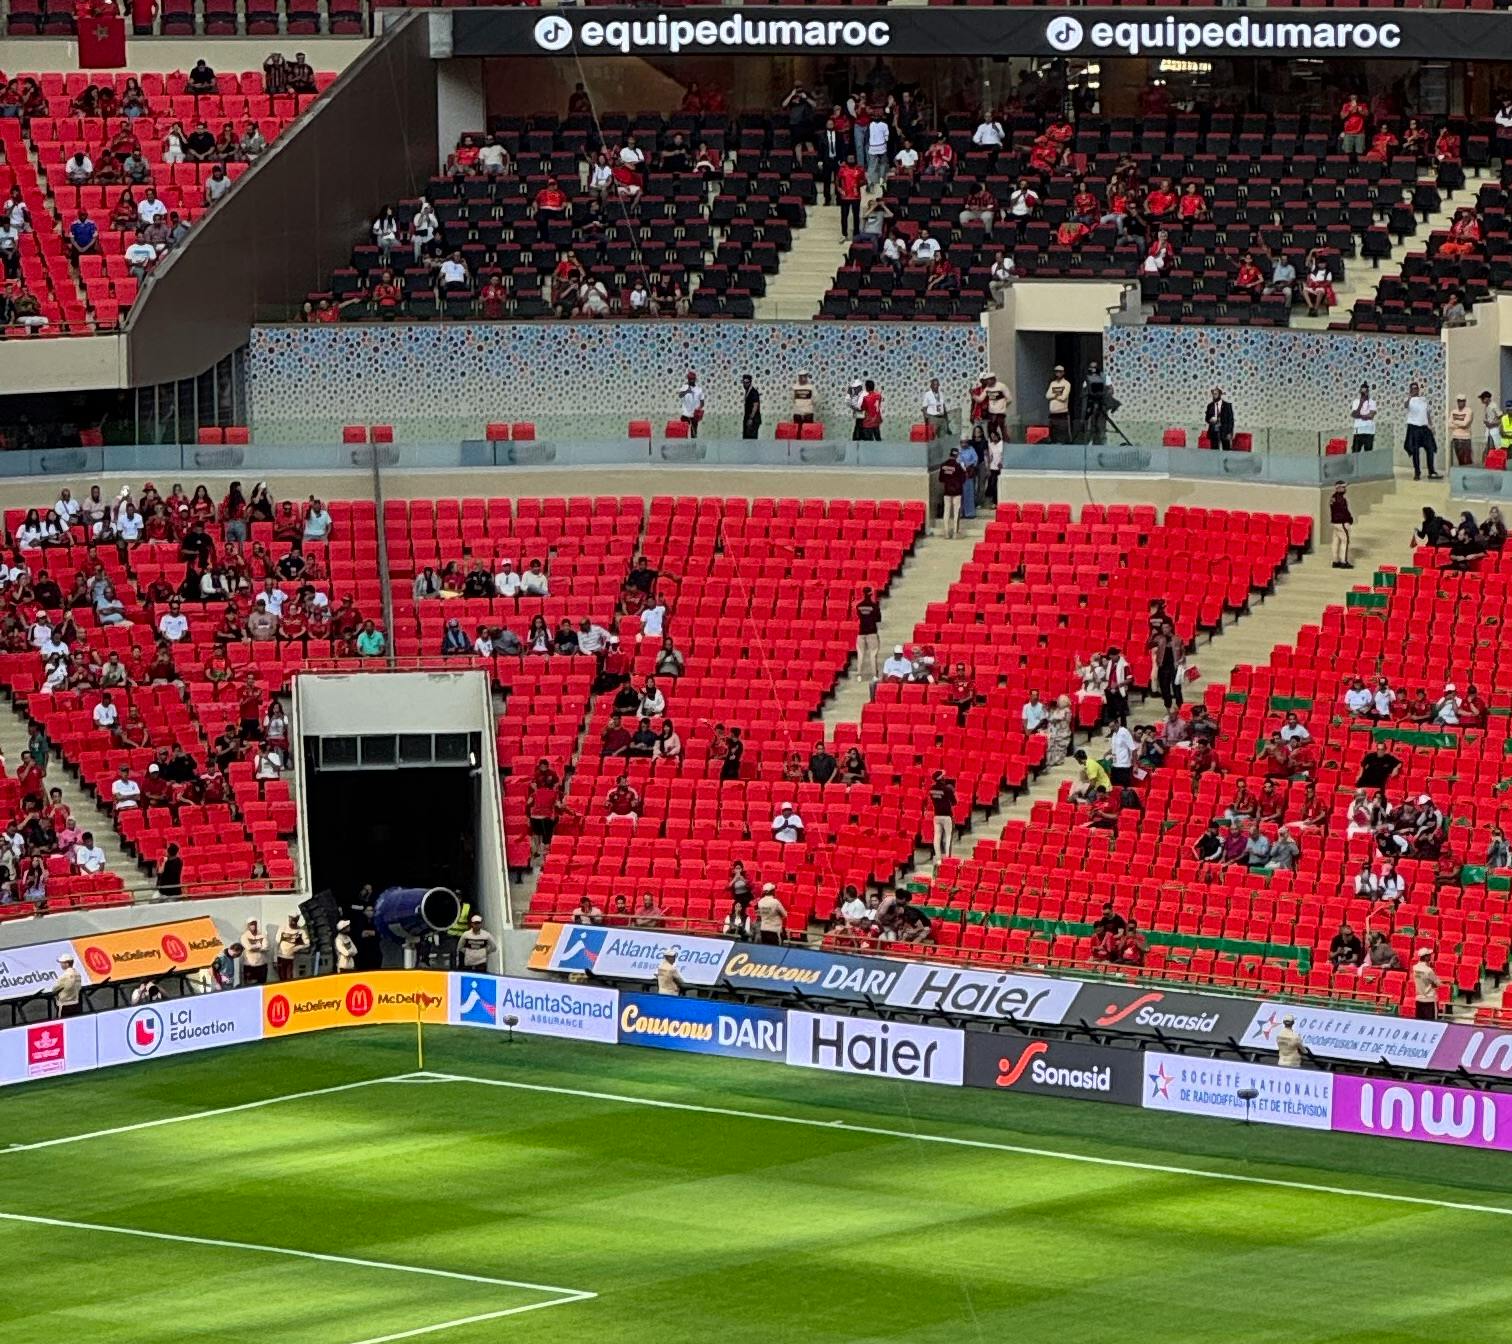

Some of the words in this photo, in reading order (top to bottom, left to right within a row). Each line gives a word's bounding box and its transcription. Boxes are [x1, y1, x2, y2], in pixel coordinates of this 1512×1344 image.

[581, 14, 889, 52] equipedumaroc
[1091, 16, 1400, 54] equipedumaroc
[0, 970, 58, 988] ducation
[724, 952, 822, 985] Couscous
[822, 965, 897, 997] DARI
[502, 988, 613, 1021] AtlantaSanad
[911, 968, 1049, 1019] Haier
[169, 1009, 192, 1027] LCI
[170, 1019, 234, 1042] Education
[530, 1013, 583, 1029] ASSURANCE
[621, 1004, 713, 1041] Couscous
[717, 1016, 783, 1053] DARI
[1136, 1004, 1219, 1034] Sonasid
[1298, 1017, 1351, 1034] OCIÉTÉ
[1358, 1025, 1439, 1044] NATIONALE
[812, 1020, 937, 1079] Haier
[1031, 1059, 1111, 1092] Sonasid
[1181, 1069, 1240, 1086] SOCIÉTÉ
[1250, 1077, 1329, 1099] NATIONALE
[1180, 1088, 1191, 1101] DE
[1193, 1090, 1256, 1112] RADIODIFFUSN
[1259, 1097, 1268, 1111] ET
[1270, 1099, 1280, 1112] DE
[1283, 1099, 1328, 1119] TÉLÉVISION
